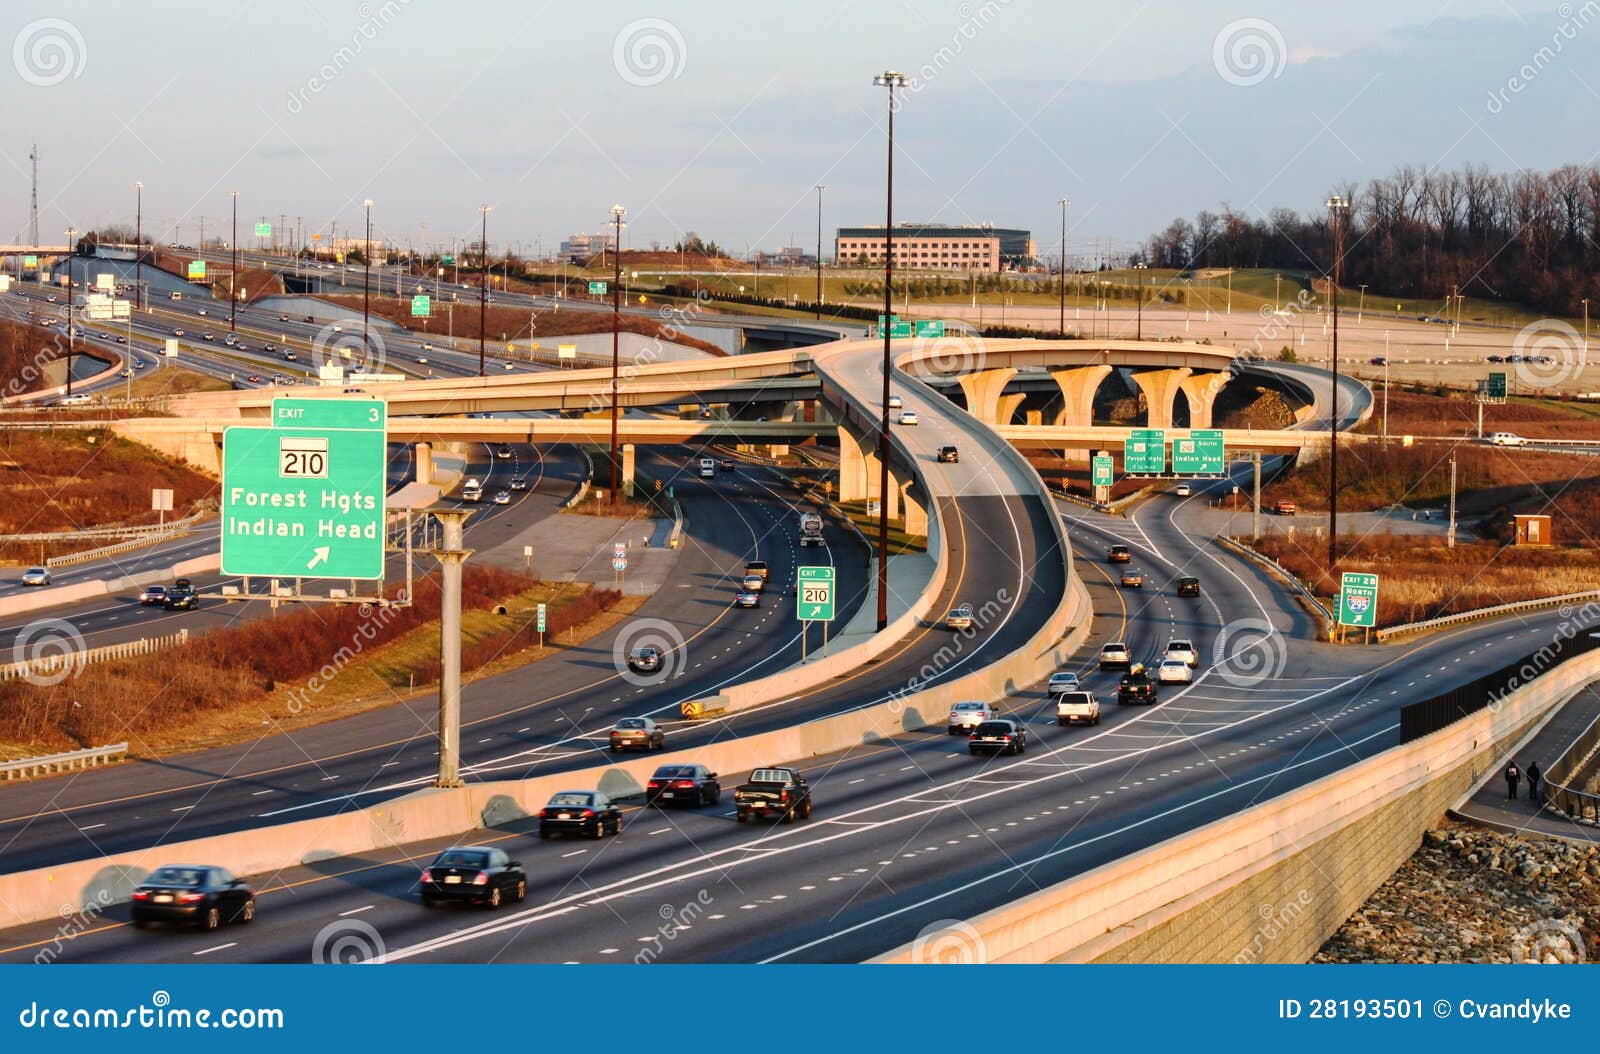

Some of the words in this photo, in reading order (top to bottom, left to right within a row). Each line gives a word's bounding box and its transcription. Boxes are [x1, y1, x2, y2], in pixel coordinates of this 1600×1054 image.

[278, 408, 304, 419] EXIT
[368, 408, 380, 422] 3
[284, 453, 324, 475] 210
[231, 488, 307, 508] Forest
[321, 490, 376, 514] Hgts
[230, 517, 305, 537] Indian
[318, 519, 377, 539] Head
[1363, 577, 1376, 585] 2B
[805, 590, 828, 602] 210
[1351, 600, 1367, 610] 295
